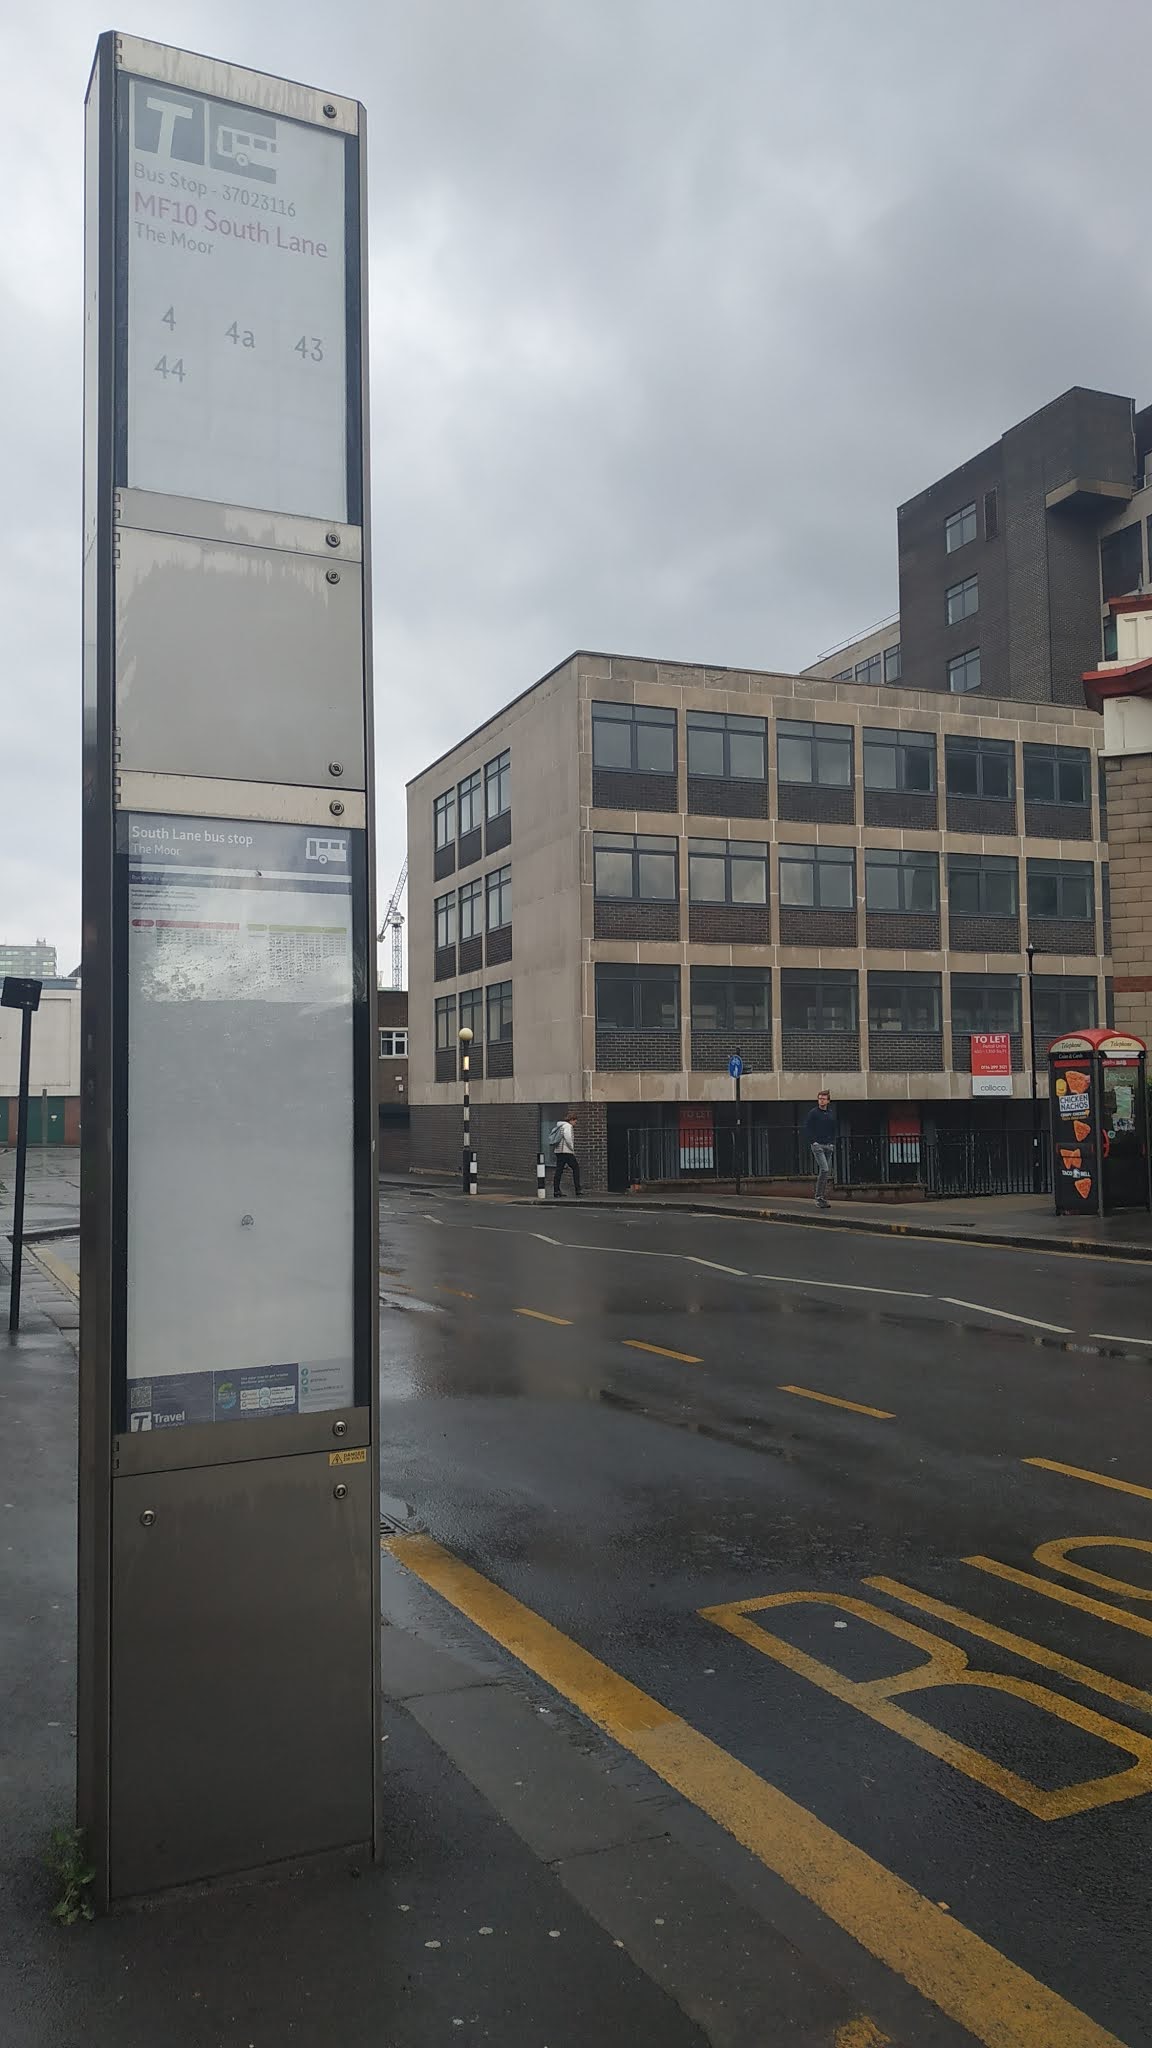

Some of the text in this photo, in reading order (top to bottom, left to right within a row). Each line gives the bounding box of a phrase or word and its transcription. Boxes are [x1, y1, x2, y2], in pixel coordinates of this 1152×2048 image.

[134, 161, 165, 185] Bus
[170, 171, 208, 198] Stop
[222, 184, 297, 218] 37023116
[134, 191, 328, 259] MF10 South Lane
[134, 220, 214, 256] The Moor
[161, 306, 324, 362] 4 4a 43
[154, 355, 187, 383] 44
[132, 825, 253, 848] South Lane bus stop
[132, 842, 181, 856] The Moor
[973, 1035, 1007, 1044] TO LET
[1060, 1094, 1088, 1104] CHICKEN
[1060, 1102, 1089, 1110] NACHOS
[152, 1410, 186, 1424] Travel
